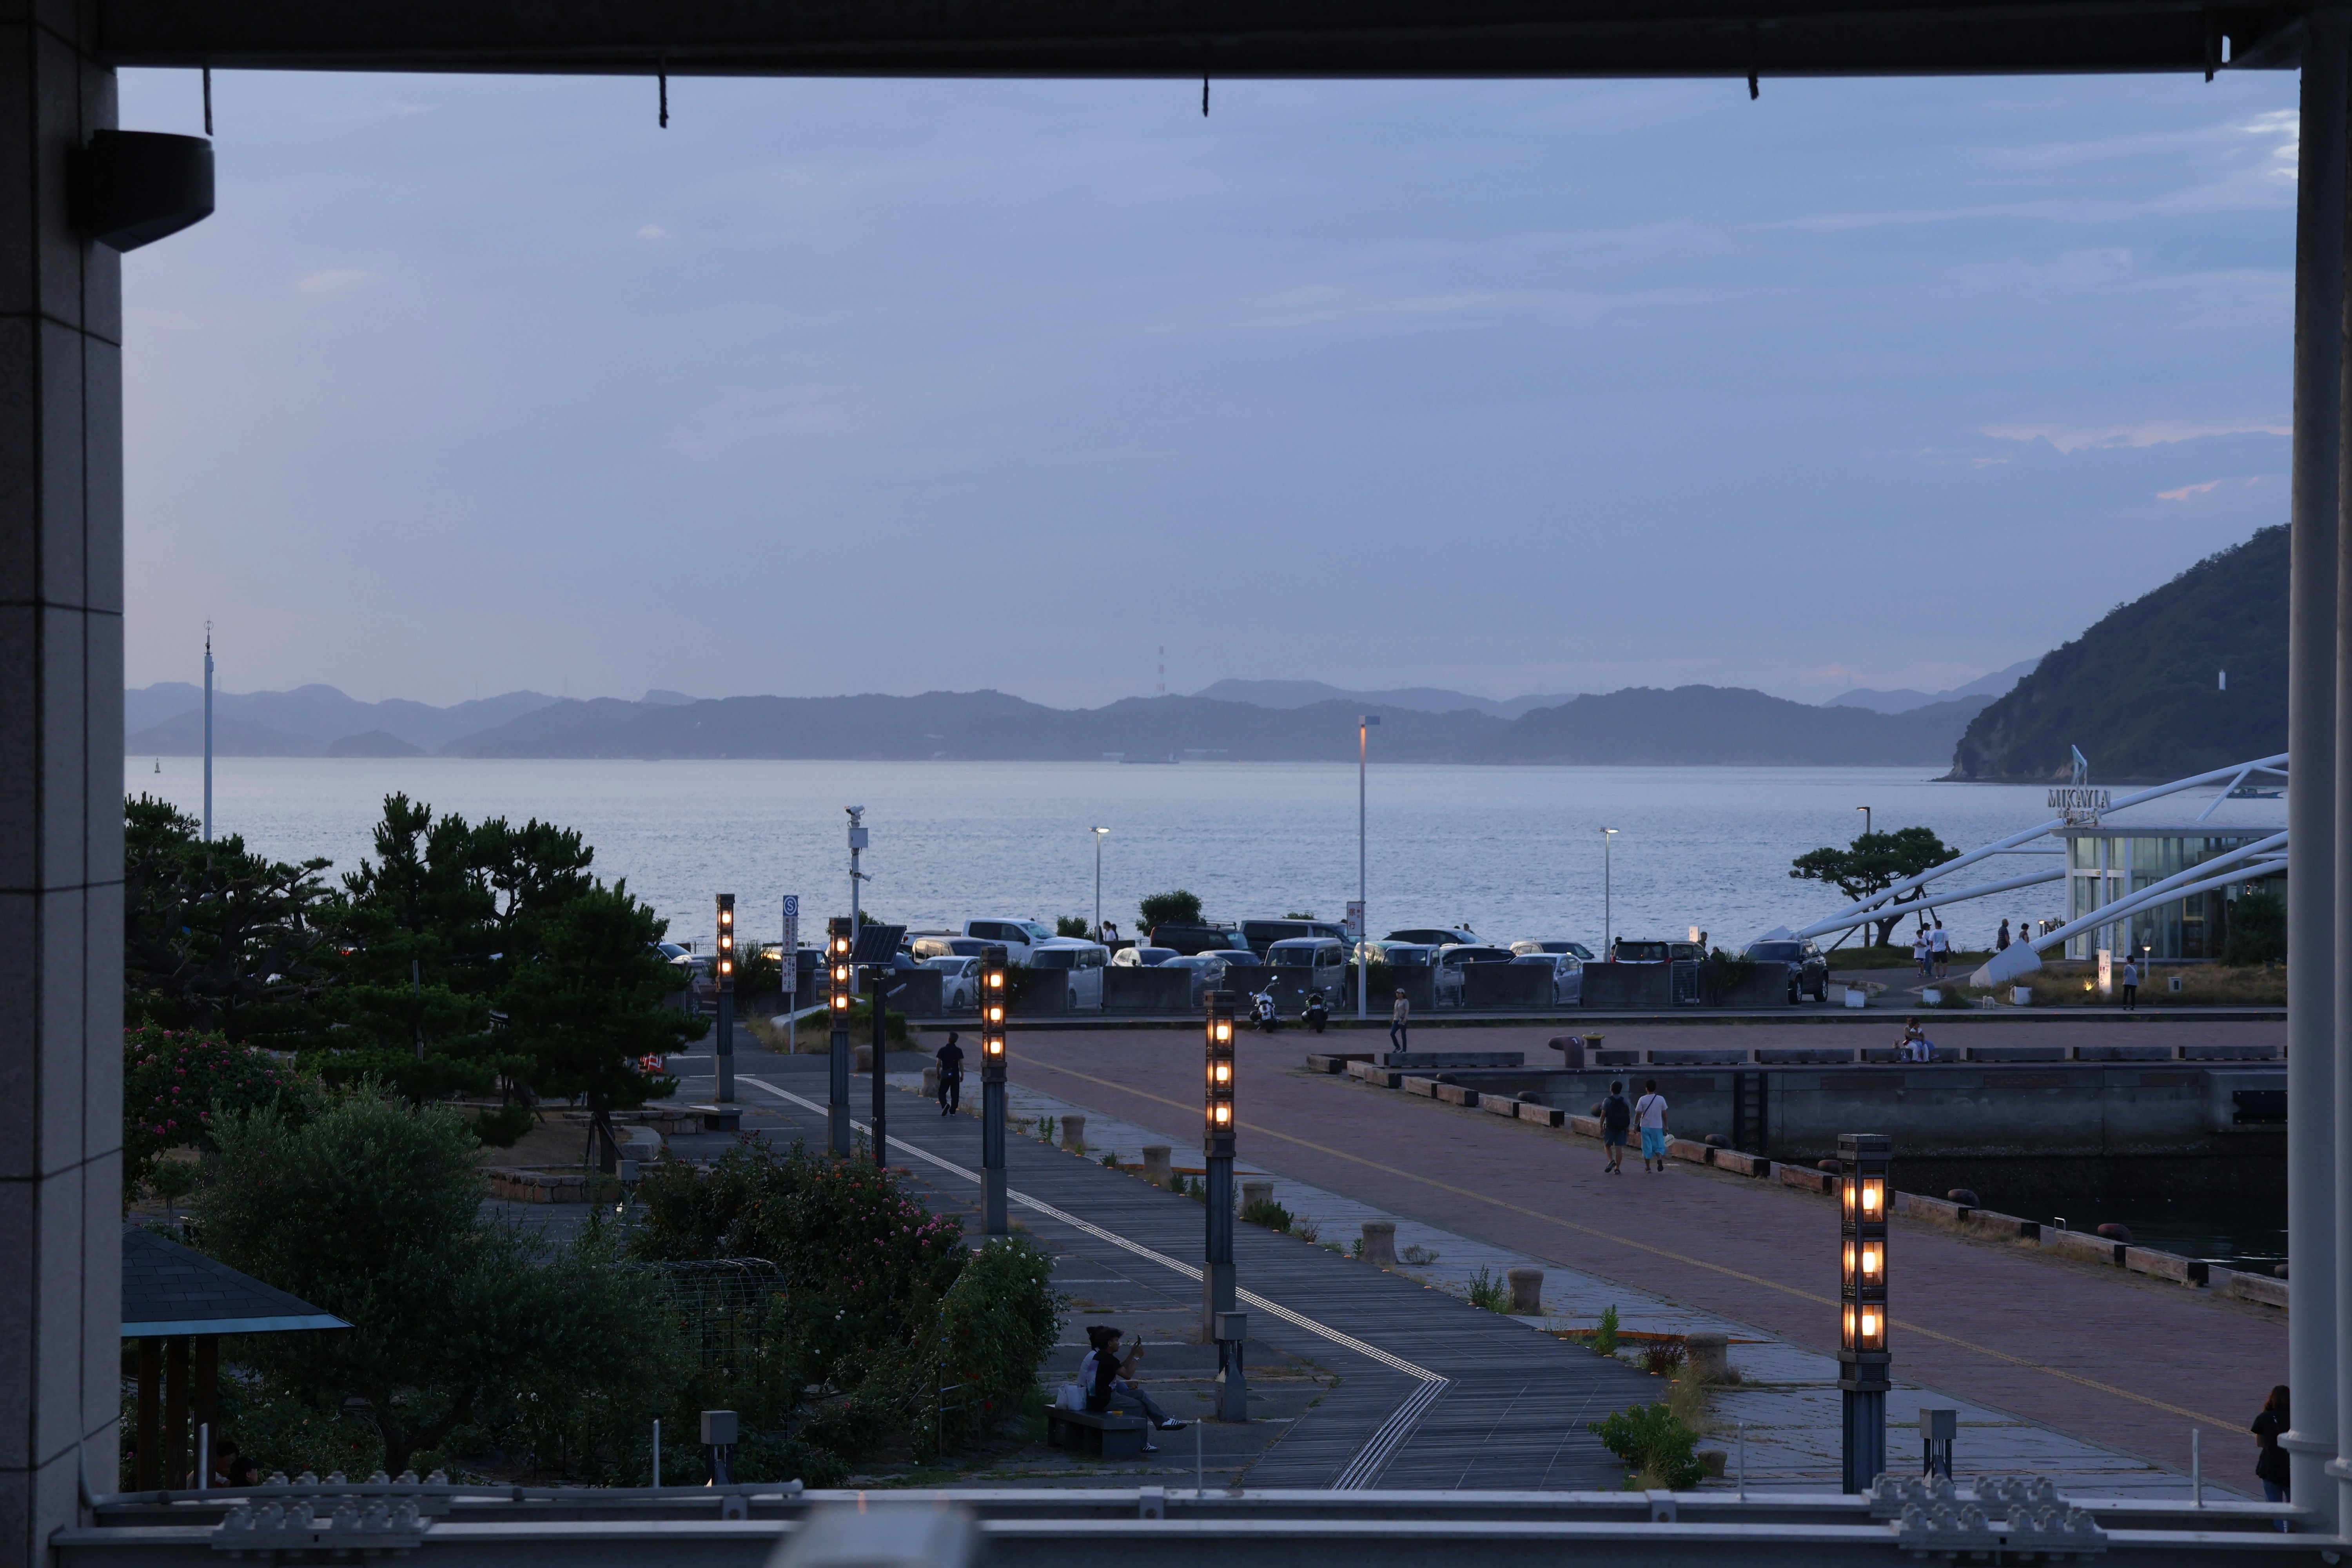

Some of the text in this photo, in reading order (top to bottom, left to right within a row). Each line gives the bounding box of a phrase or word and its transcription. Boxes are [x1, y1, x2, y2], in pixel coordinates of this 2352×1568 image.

[2048, 789, 2111, 809] MIKAYLA
[787, 900, 793, 911] S
[1349, 908, 1356, 930] 徐行
